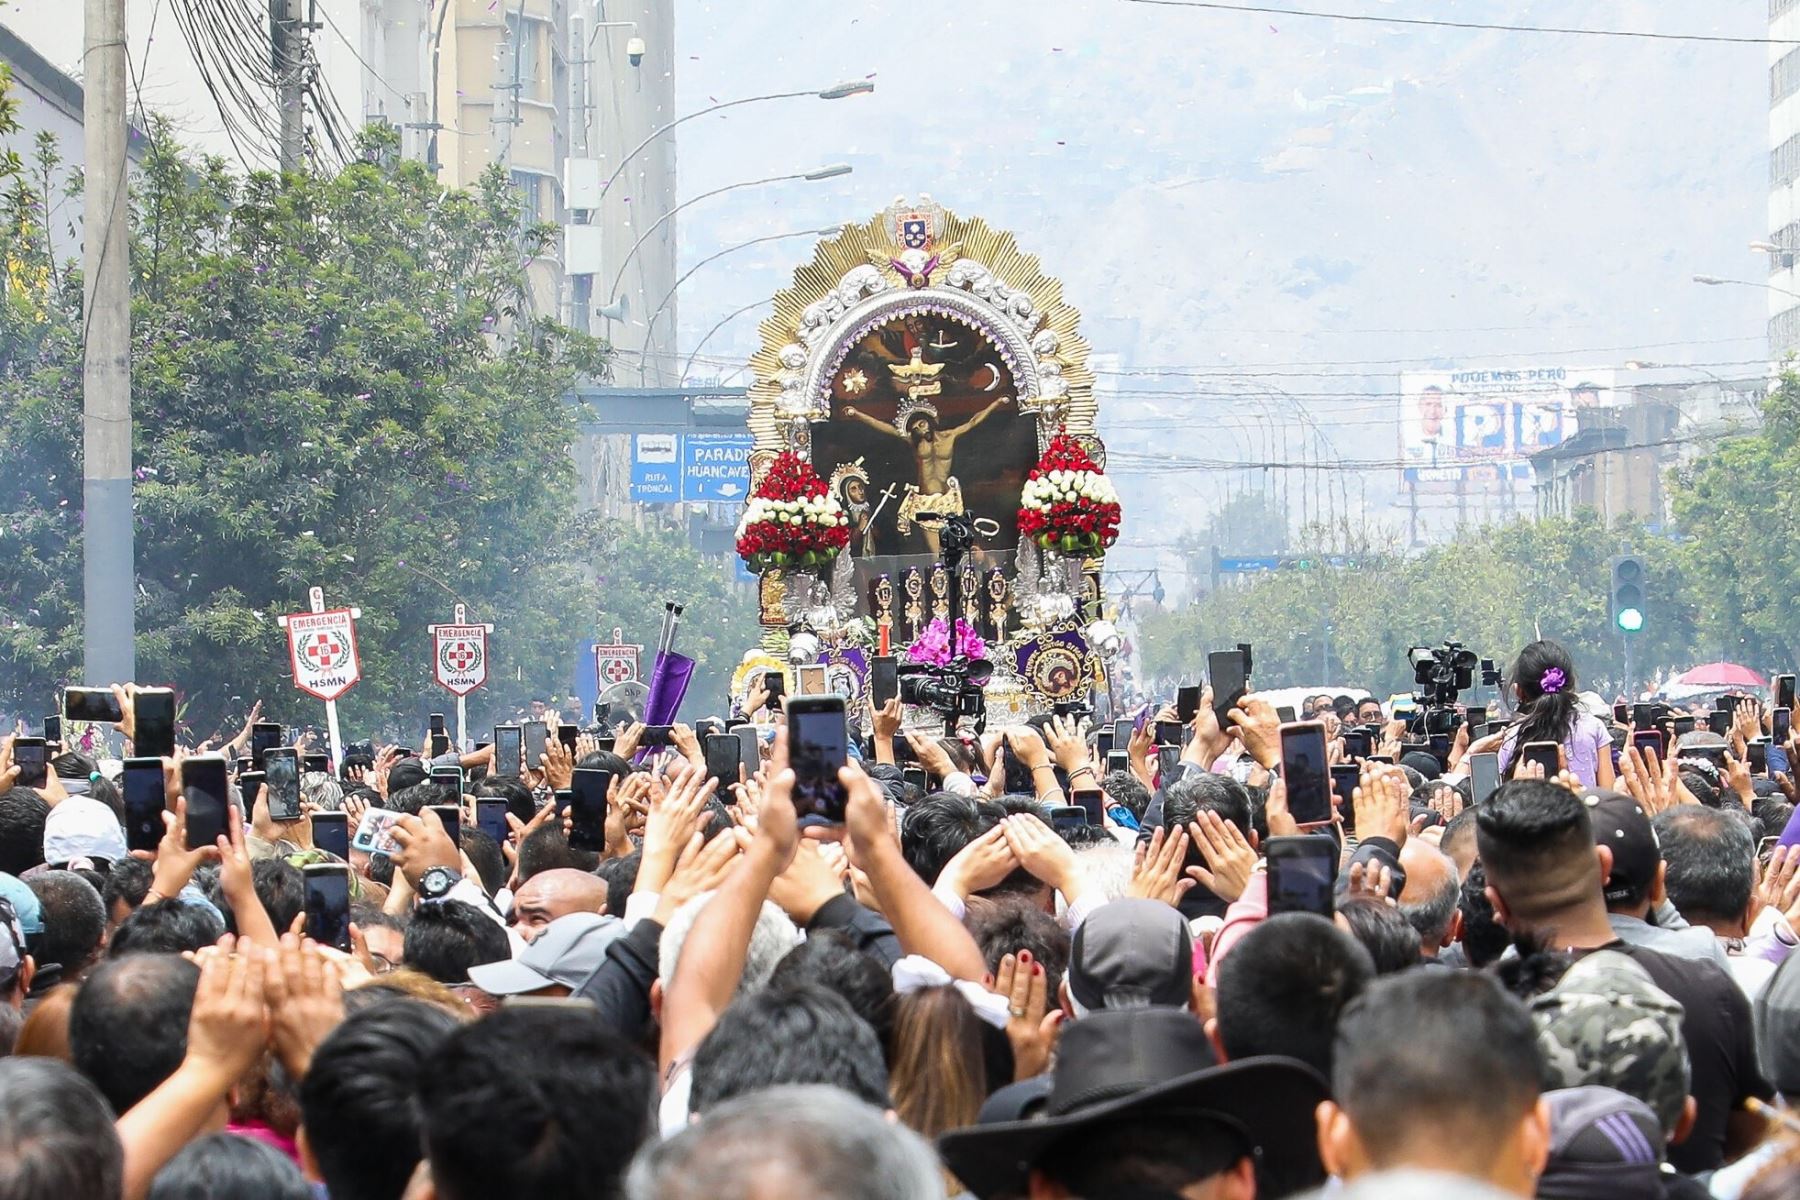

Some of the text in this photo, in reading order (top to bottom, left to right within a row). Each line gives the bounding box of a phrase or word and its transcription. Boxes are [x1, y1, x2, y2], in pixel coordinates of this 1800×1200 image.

[645, 473, 667, 482] RUTA
[292, 614, 348, 630] EMERGENCIA
[438, 629, 482, 638] EMERGENCIA
[319, 644, 330, 656] 16
[309, 676, 347, 689] HSMN
[447, 678, 476, 686] HSMN
